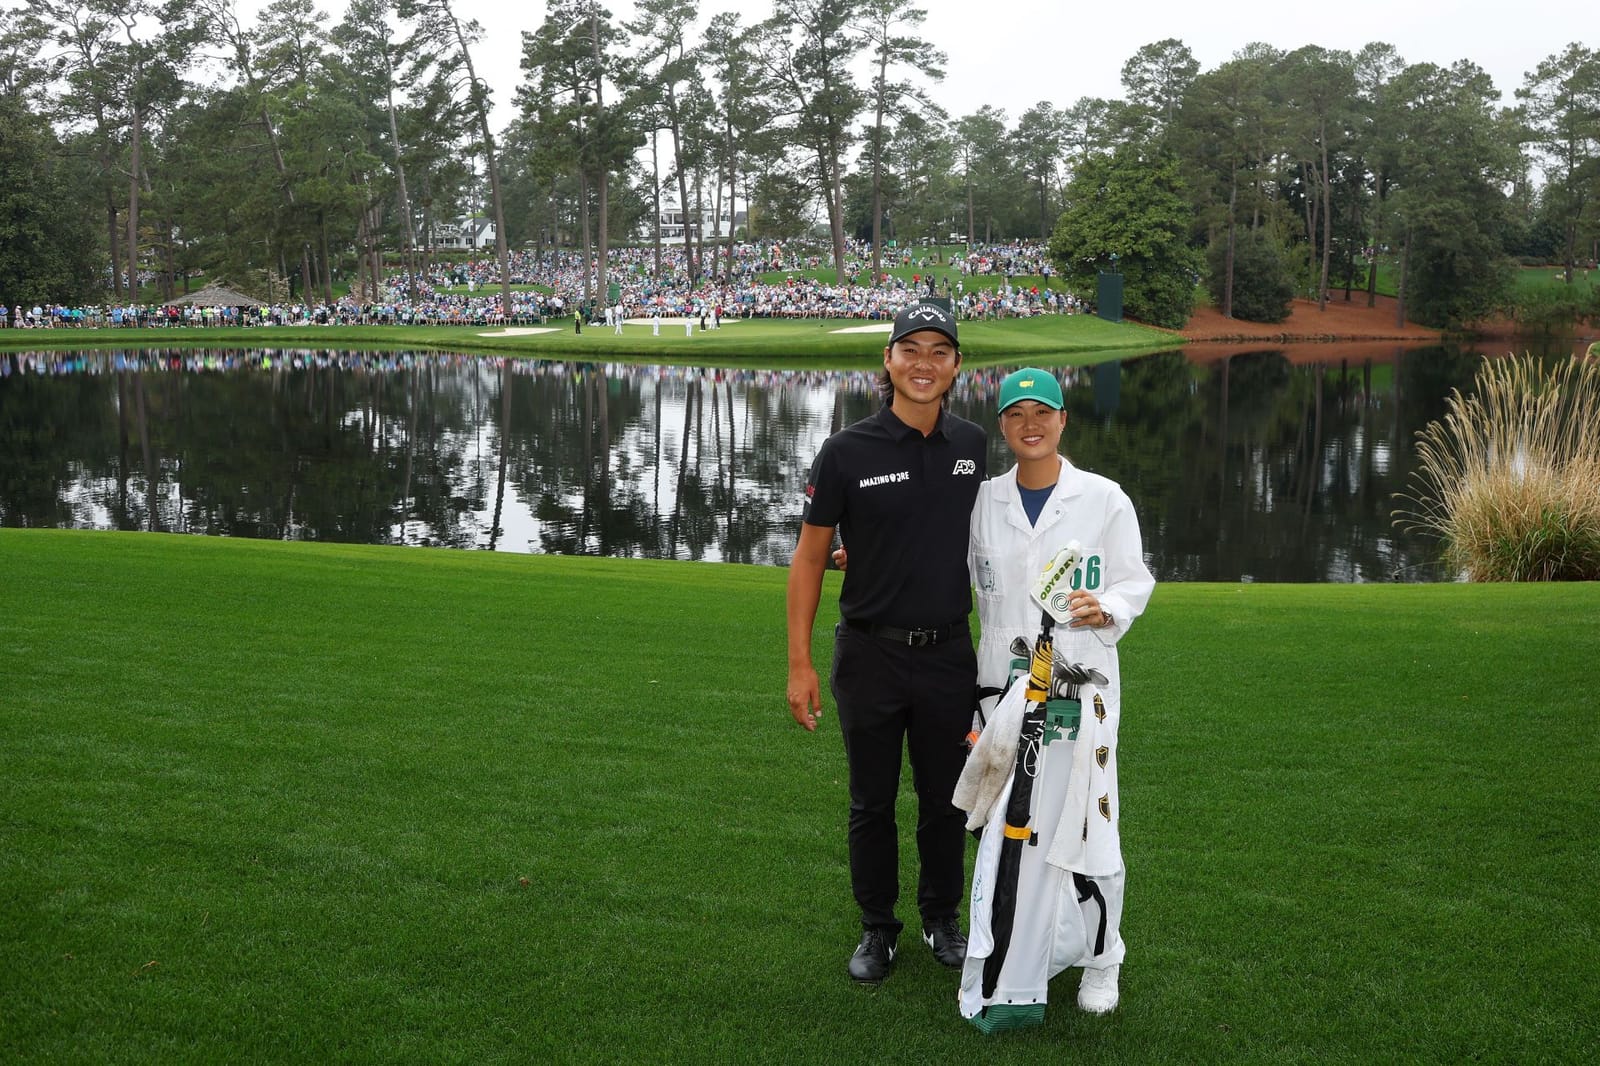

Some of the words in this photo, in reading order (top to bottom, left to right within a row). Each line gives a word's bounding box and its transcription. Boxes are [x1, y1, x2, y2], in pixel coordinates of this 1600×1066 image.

[908, 306, 947, 322] Callaway
[859, 474, 890, 489] AMAZING
[1040, 555, 1074, 601] ODYSSEY
